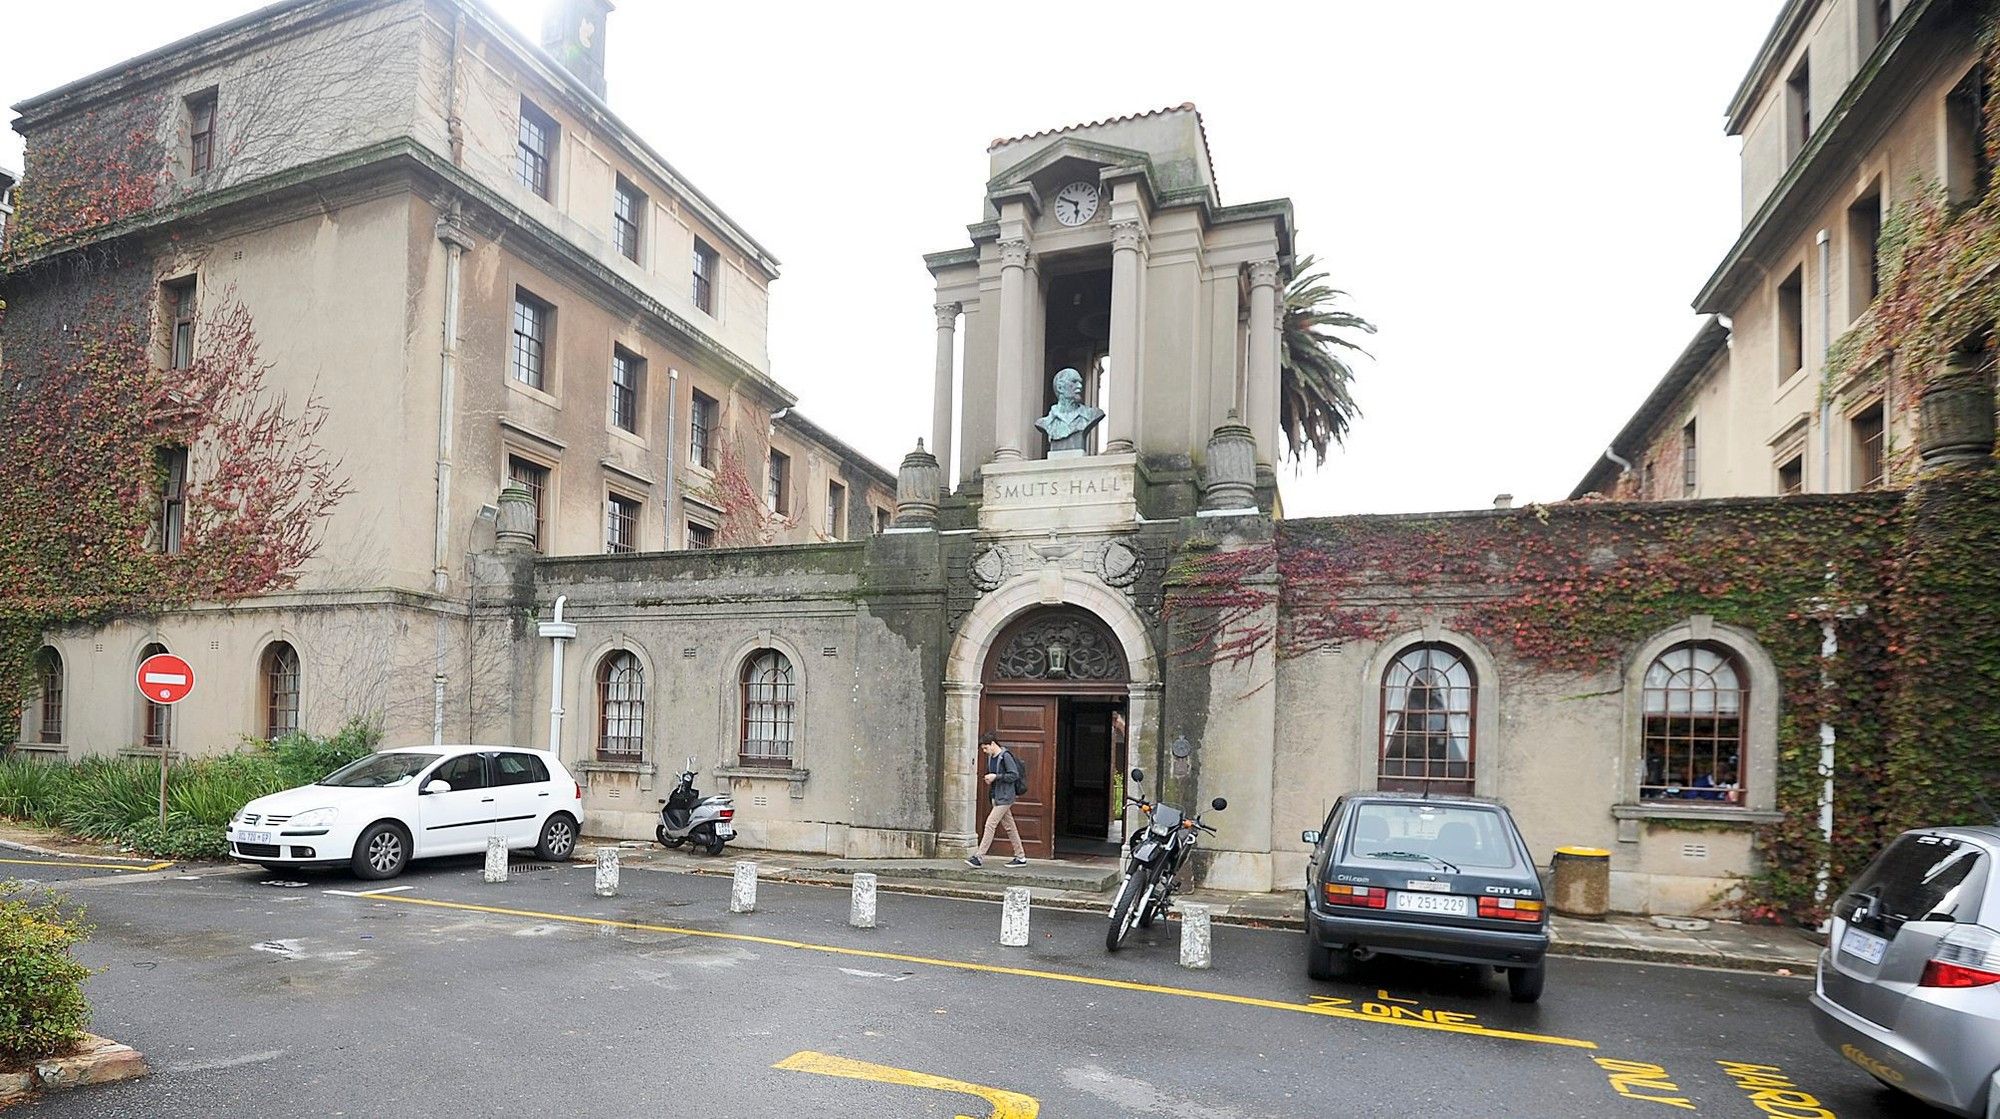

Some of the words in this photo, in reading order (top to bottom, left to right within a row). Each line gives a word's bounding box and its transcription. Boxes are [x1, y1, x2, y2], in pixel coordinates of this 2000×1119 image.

[994, 481, 1059, 499] SMUTS
[1069, 477, 1121, 494] HALL
[1399, 895, 1413, 907] CY
[1417, 896, 1465, 912] 251-229
[1306, 995, 1484, 1029] ZONE
